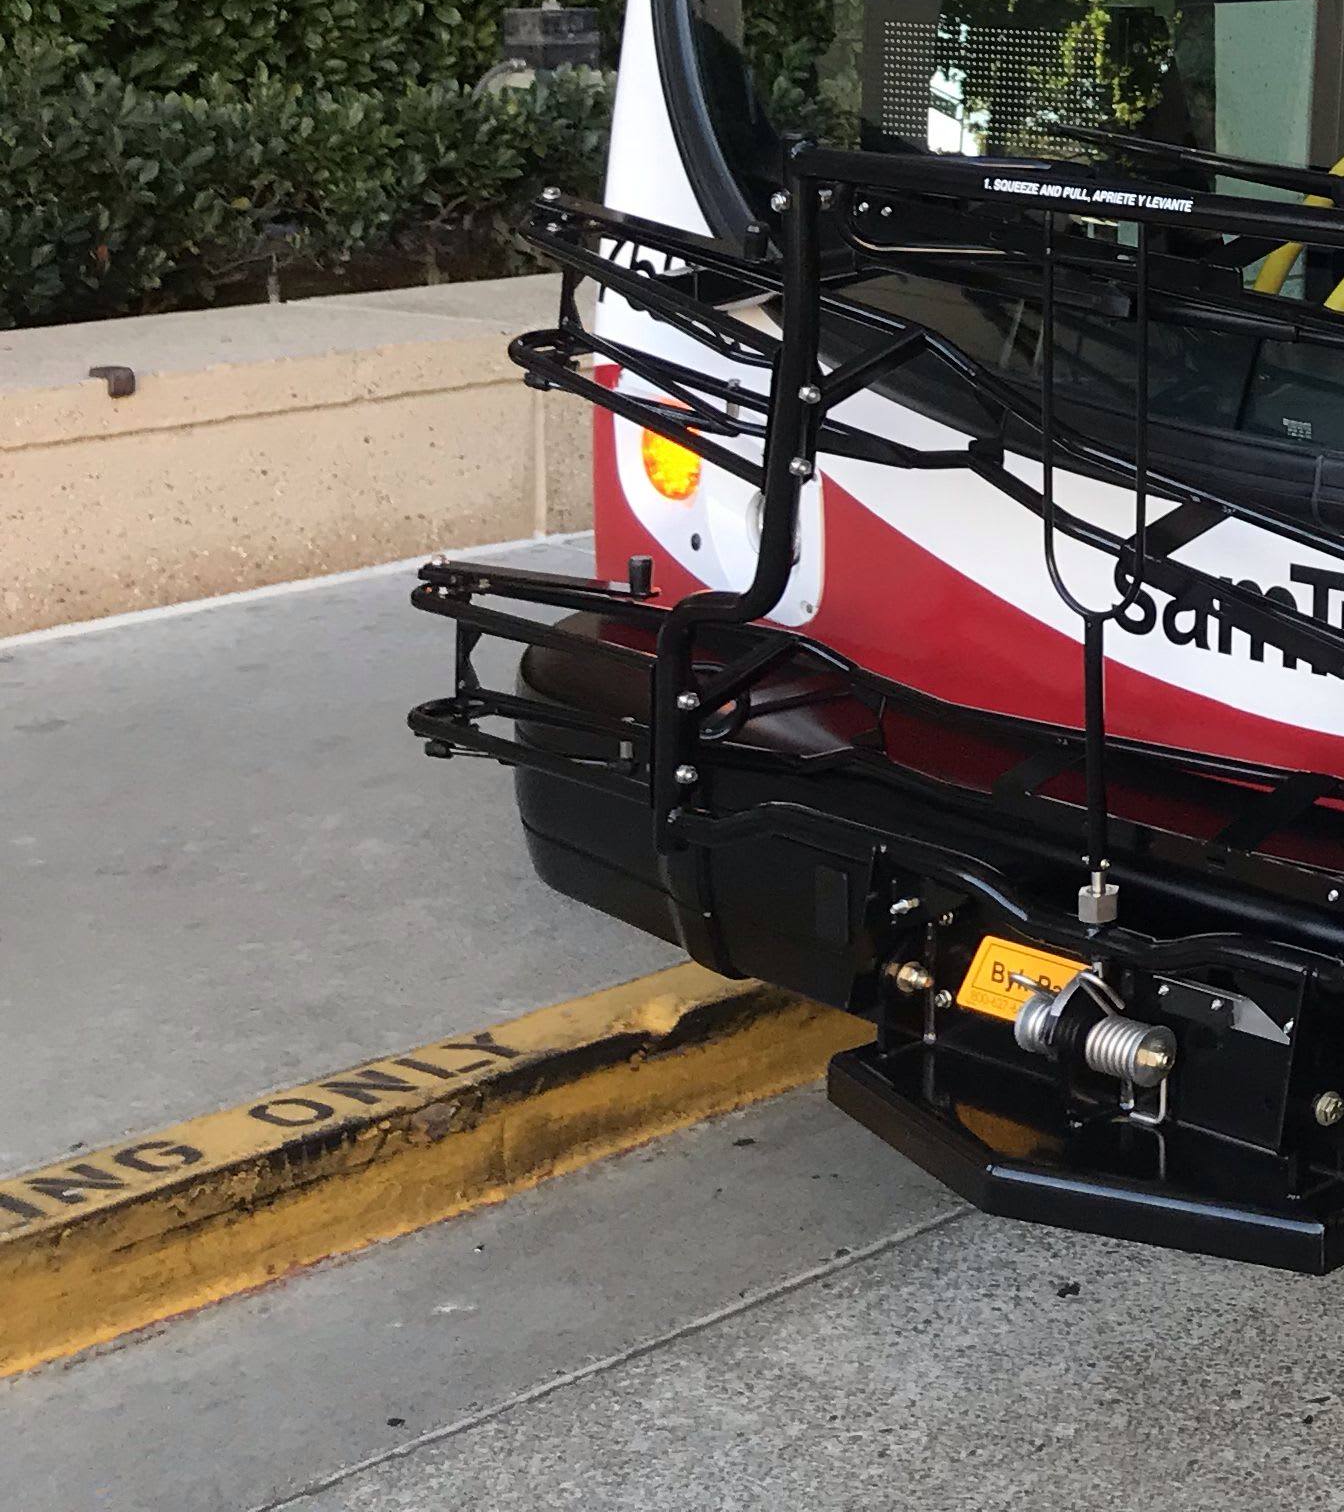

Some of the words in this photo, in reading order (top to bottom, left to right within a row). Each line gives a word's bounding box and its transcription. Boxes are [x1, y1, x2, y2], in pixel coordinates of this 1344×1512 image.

[984, 177, 992, 190] 1.
[993, 178, 1040, 195] SQUEEZE
[1039, 183, 1062, 198] AND
[1062, 186, 1090, 202] PULL,
[1092, 189, 1137, 206] APRIETE
[1137, 195, 1147, 207] Y
[1146, 196, 1194, 213] LEVANTE
[249, 1032, 522, 1128] ONLY
